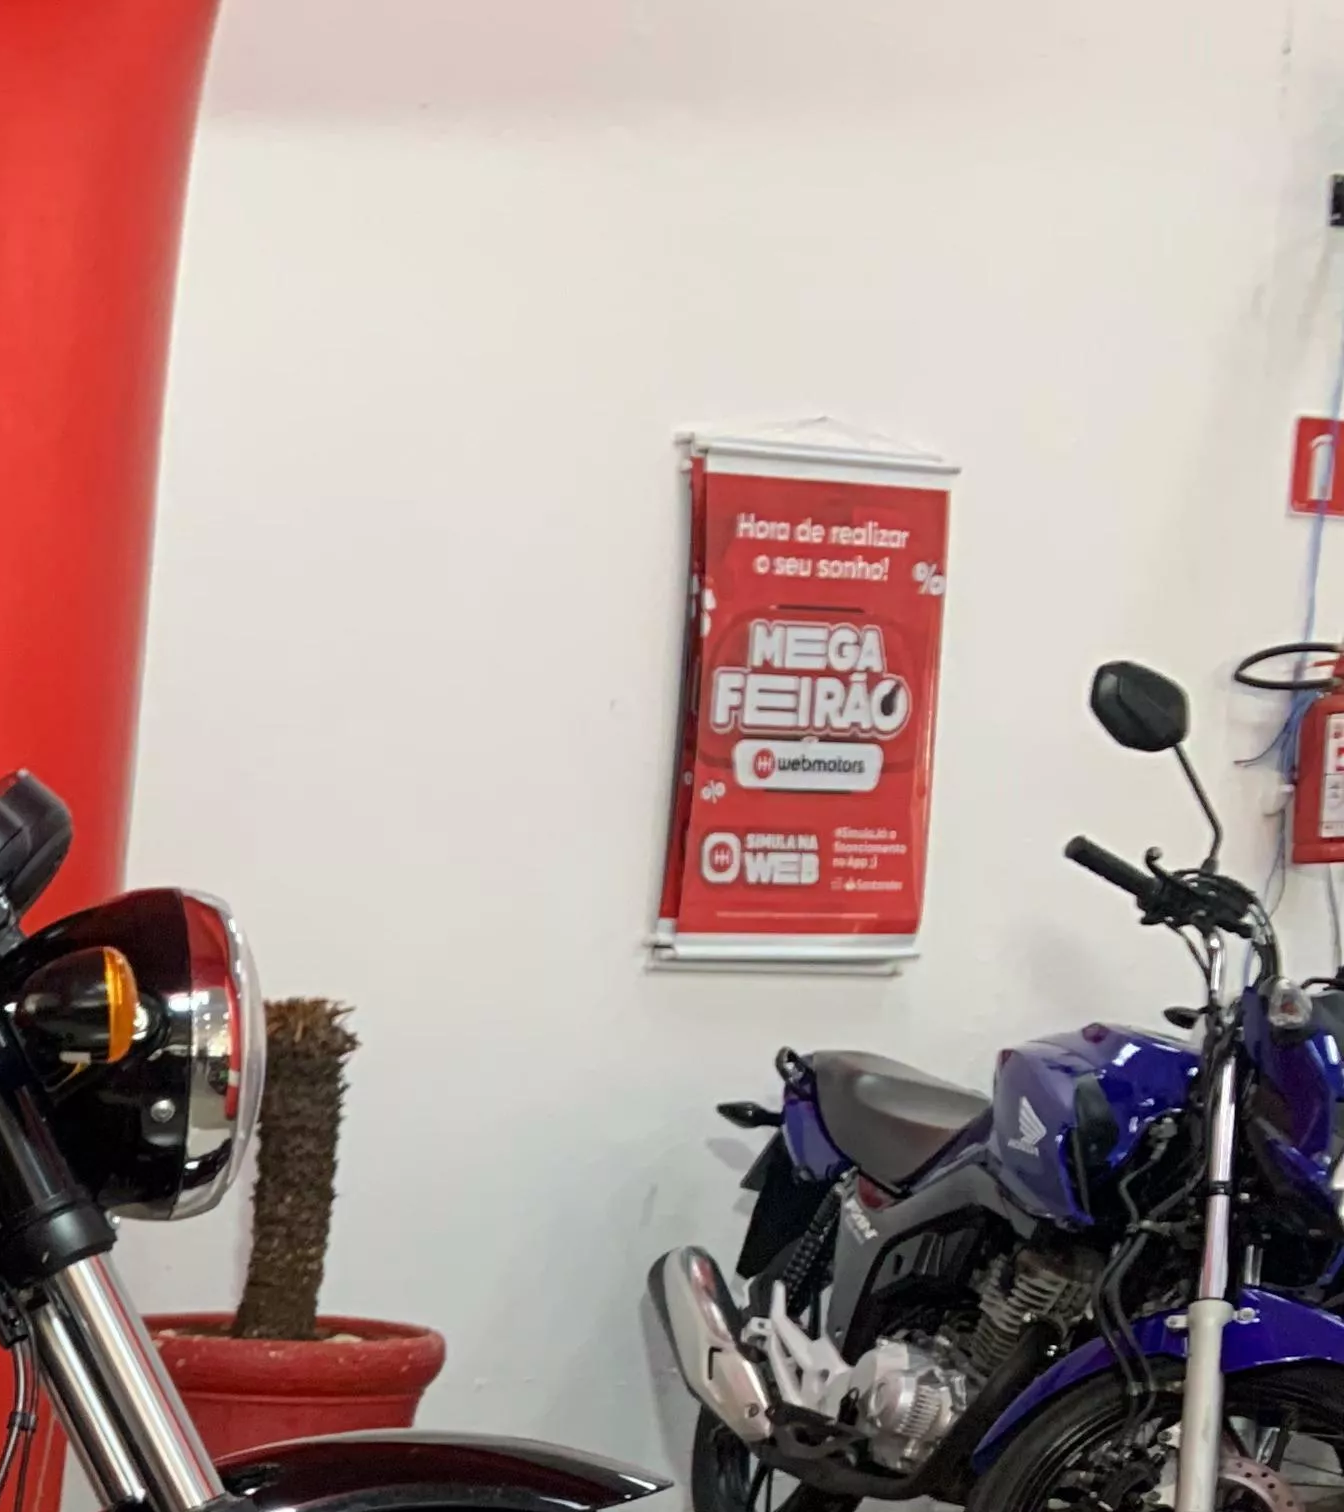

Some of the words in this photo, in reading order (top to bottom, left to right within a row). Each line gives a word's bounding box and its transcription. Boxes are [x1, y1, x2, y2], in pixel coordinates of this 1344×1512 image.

[737, 513, 790, 540] Hora
[795, 517, 825, 543] de
[828, 521, 910, 549] realizar
[753, 555, 770, 574] o
[773, 556, 811, 577] seu
[816, 555, 890, 581] sonho!
[751, 622, 885, 673] MEGA
[713, 672, 909, 732] FEIRÃO
[777, 754, 865, 774] webmotors
[745, 833, 795, 849] SIMULA
[744, 852, 820, 885] WEB
